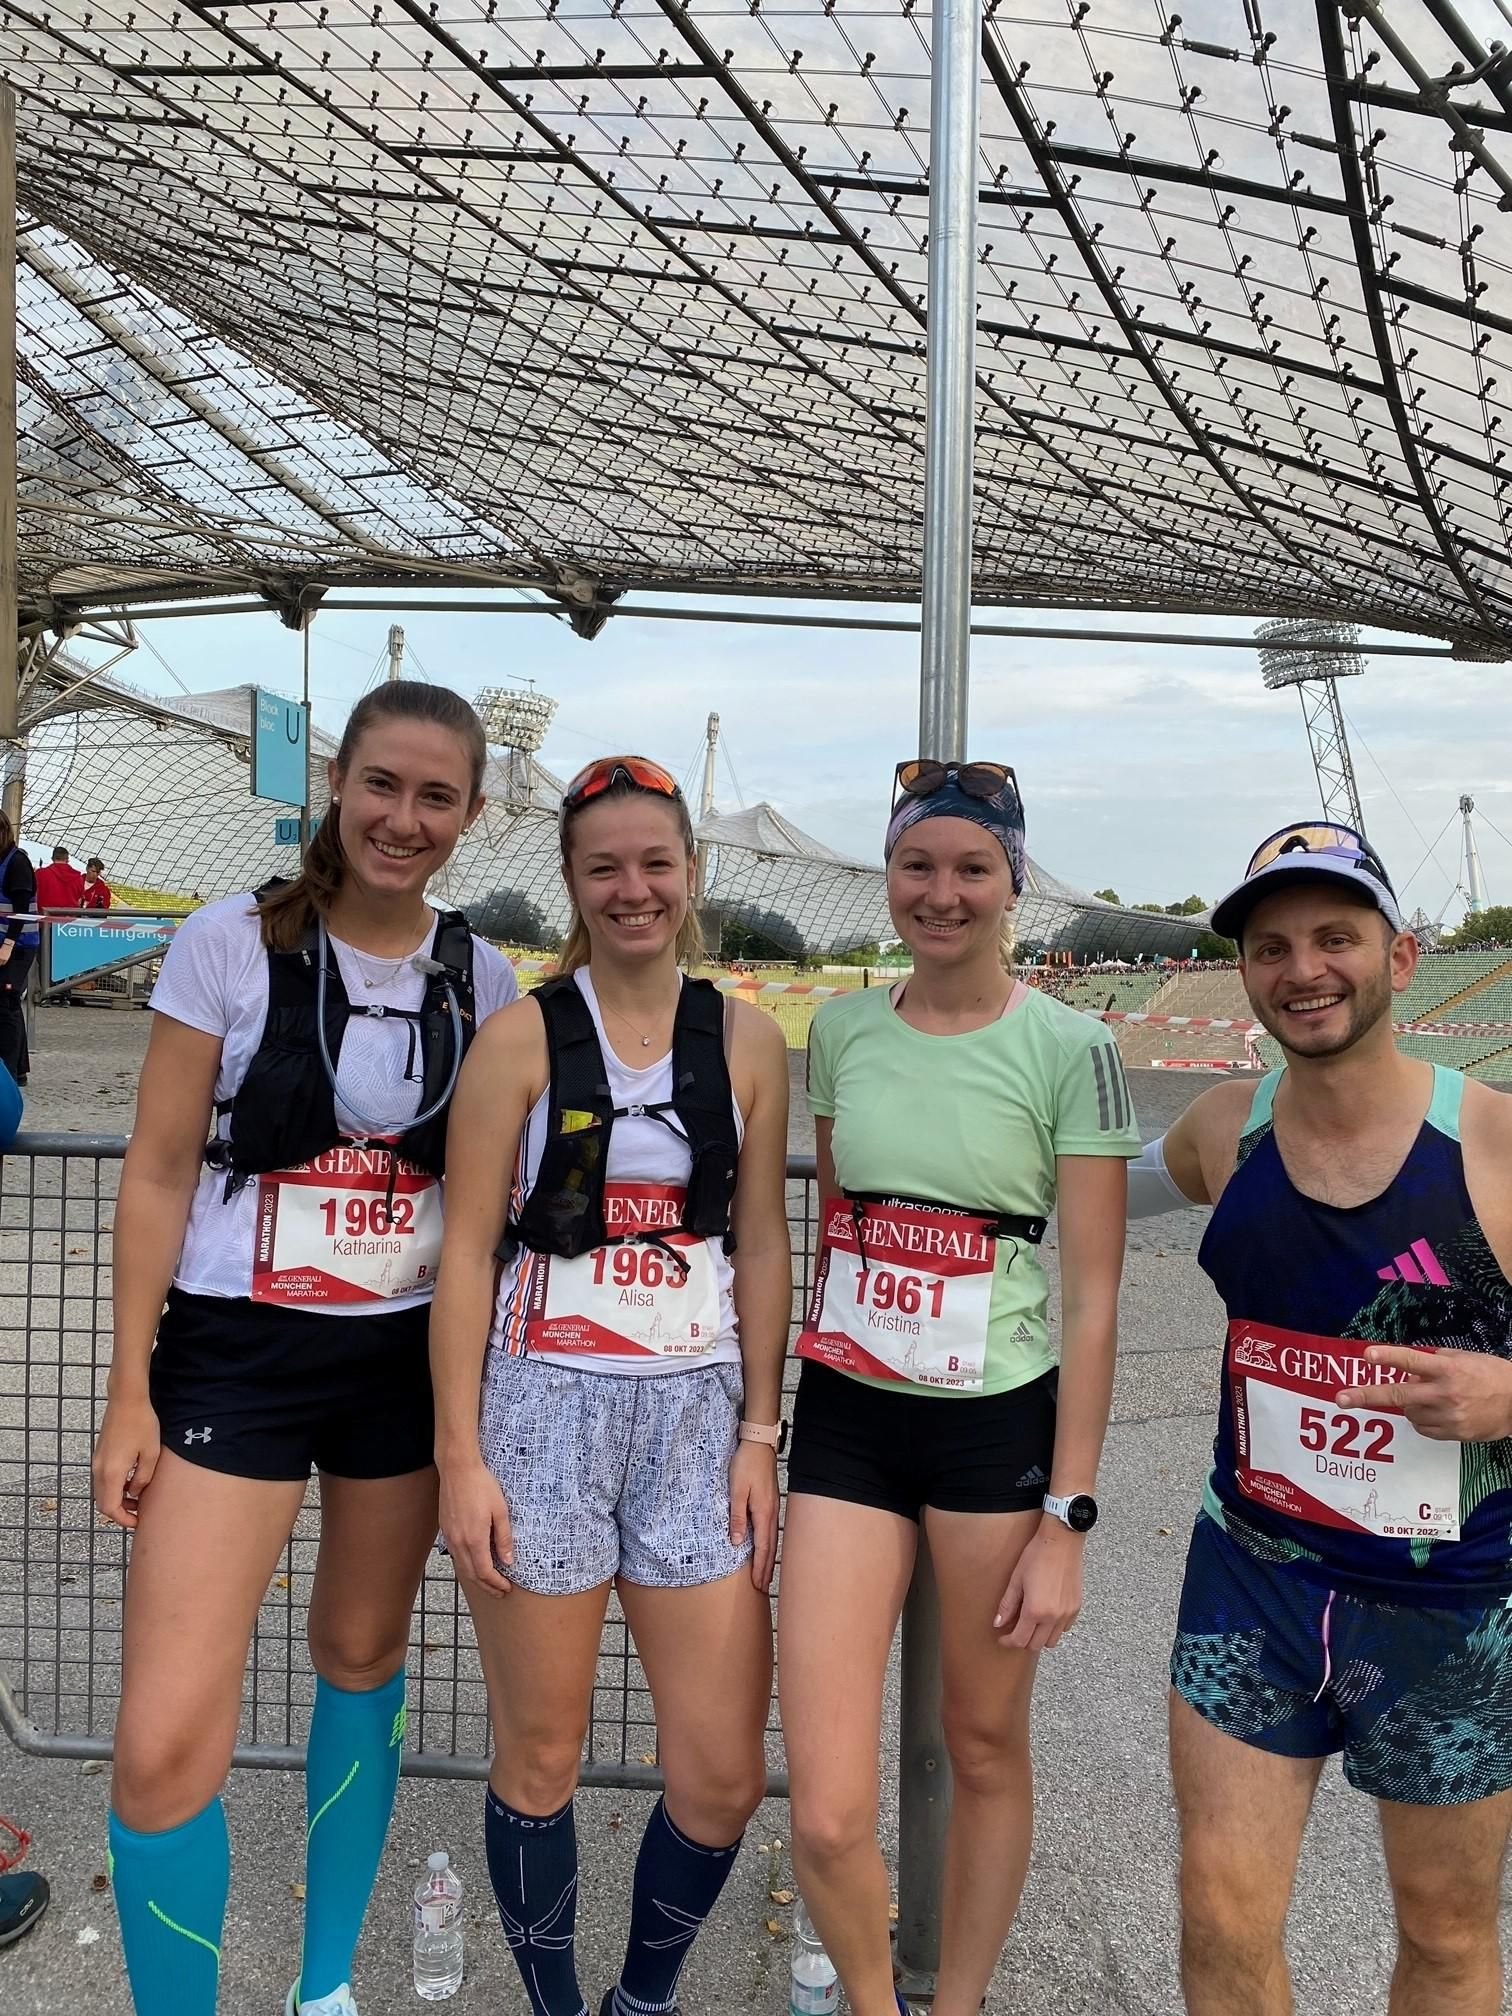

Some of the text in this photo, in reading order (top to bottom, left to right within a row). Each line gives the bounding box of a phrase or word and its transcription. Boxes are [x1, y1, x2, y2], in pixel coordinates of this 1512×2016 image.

[286, 707, 300, 745] U
[57, 923, 167, 942] Kein Eingang
[319, 1197, 416, 1237] 1962
[603, 1197, 686, 1227] ENER
[259, 1193, 274, 1263] MARATHON 2023
[333, 1237, 402, 1256] Katharina
[856, 1217, 990, 1263] GENERALI
[417, 1265, 427, 1279] B
[589, 1247, 689, 1289] 1963
[533, 1263, 546, 1310] MARATHON
[855, 1268, 945, 1319] 1961
[618, 1289, 654, 1307] Alisa
[811, 1276, 825, 1322] MARATHON
[690, 1322, 700, 1338] B
[867, 1309, 921, 1336] Kristina
[556, 1338, 597, 1348] MARATHON
[663, 1344, 673, 1353] 08
[1010, 1334, 1034, 1344] adidas
[823, 1352, 856, 1366] MARATHON
[948, 1355, 959, 1372] B
[918, 1374, 965, 1387] 08 OKT 2023
[1237, 1406, 1247, 1456] MARATHON
[1299, 1406, 1395, 1463] 522
[1315, 1454, 1377, 1483] Davide
[1016, 1475, 1050, 1488] adidas
[1264, 1493, 1302, 1513] MARATHON
[1419, 1503, 1431, 1520] C
[1383, 1525, 1395, 1534] 08
[1397, 1526, 1414, 1536] OKT
